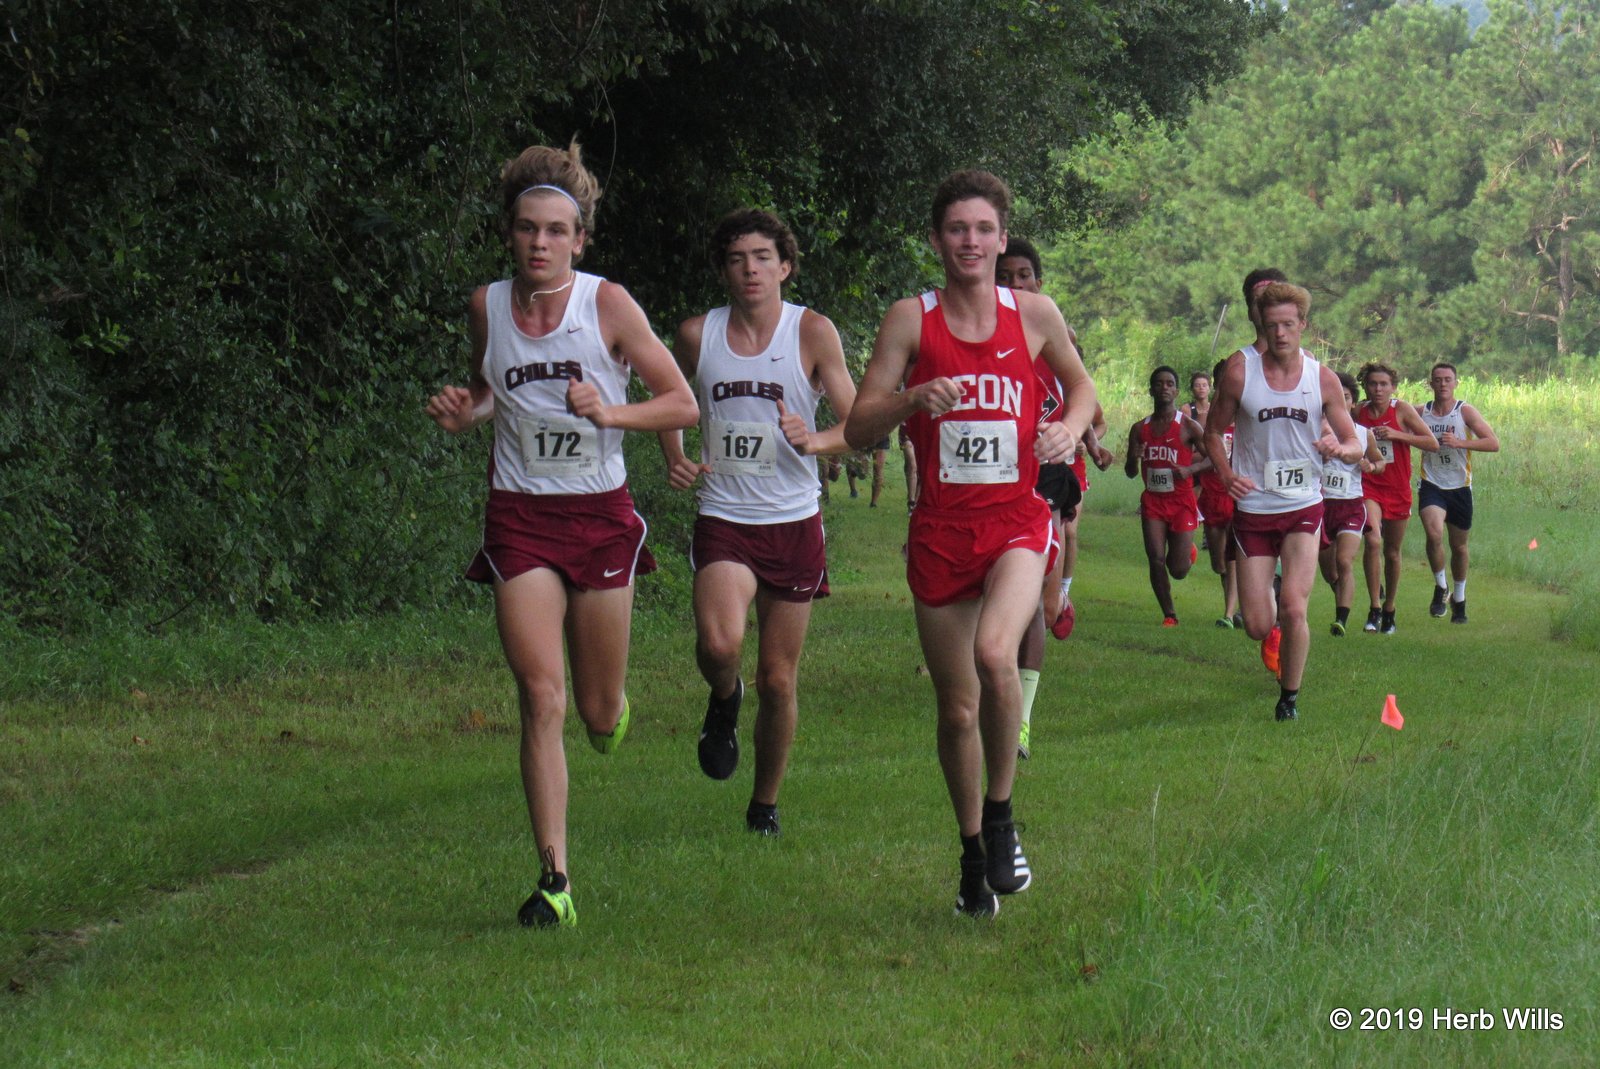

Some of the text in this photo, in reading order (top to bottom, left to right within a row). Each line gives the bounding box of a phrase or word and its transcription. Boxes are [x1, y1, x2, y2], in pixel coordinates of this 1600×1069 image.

[505, 360, 583, 391] CHILES
[712, 381, 784, 402] CHILES
[932, 374, 1022, 418] EON
[1258, 406, 1308, 424] CHILES
[534, 431, 582, 458] 172
[722, 434, 763, 459] 167
[955, 436, 1000, 463] 421
[1439, 455, 1451, 464] 15
[1151, 474, 1167, 485] 405
[1275, 468, 1304, 487] 175
[1326, 475, 1344, 488] 161
